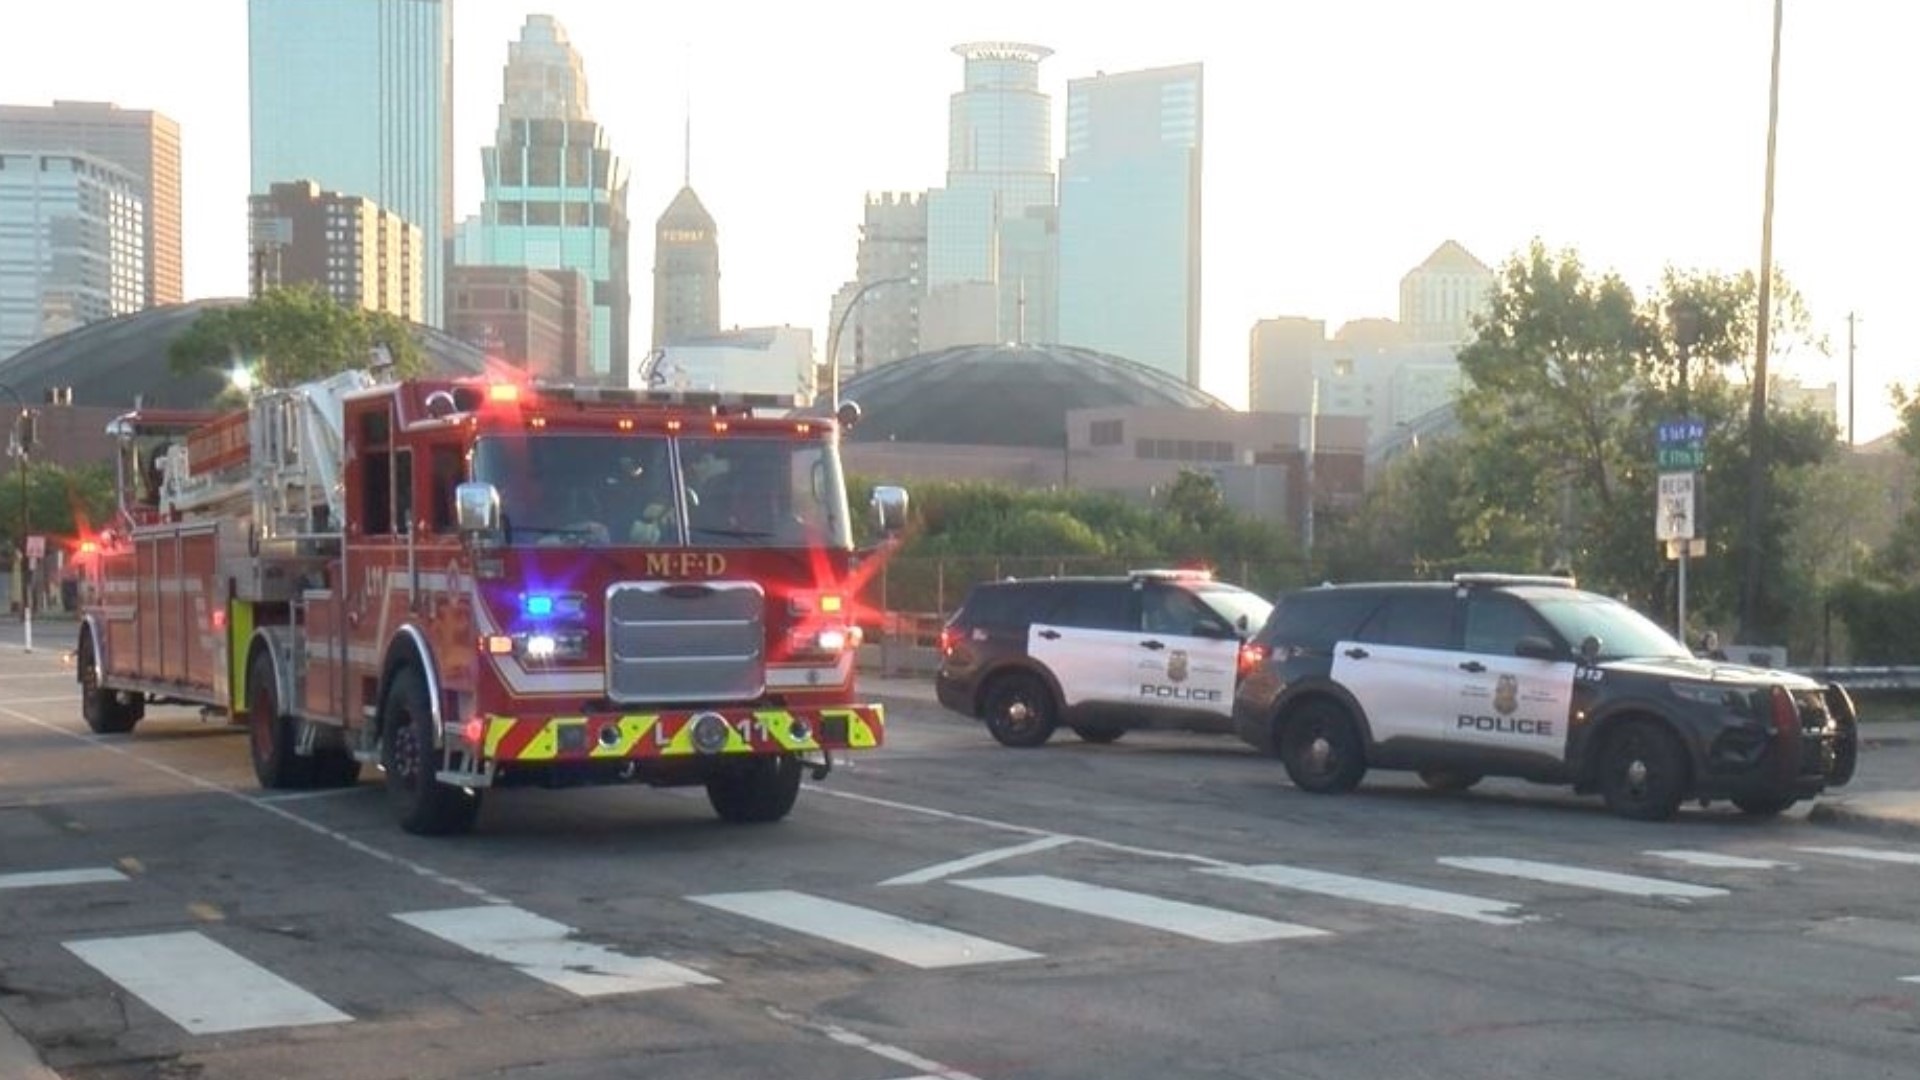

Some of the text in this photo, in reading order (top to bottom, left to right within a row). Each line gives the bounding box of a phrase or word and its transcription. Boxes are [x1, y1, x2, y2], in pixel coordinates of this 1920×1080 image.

[1140, 684, 1222, 702] POLICE
[655, 719, 769, 746] L 11
[1456, 714, 1554, 736] POLICE
